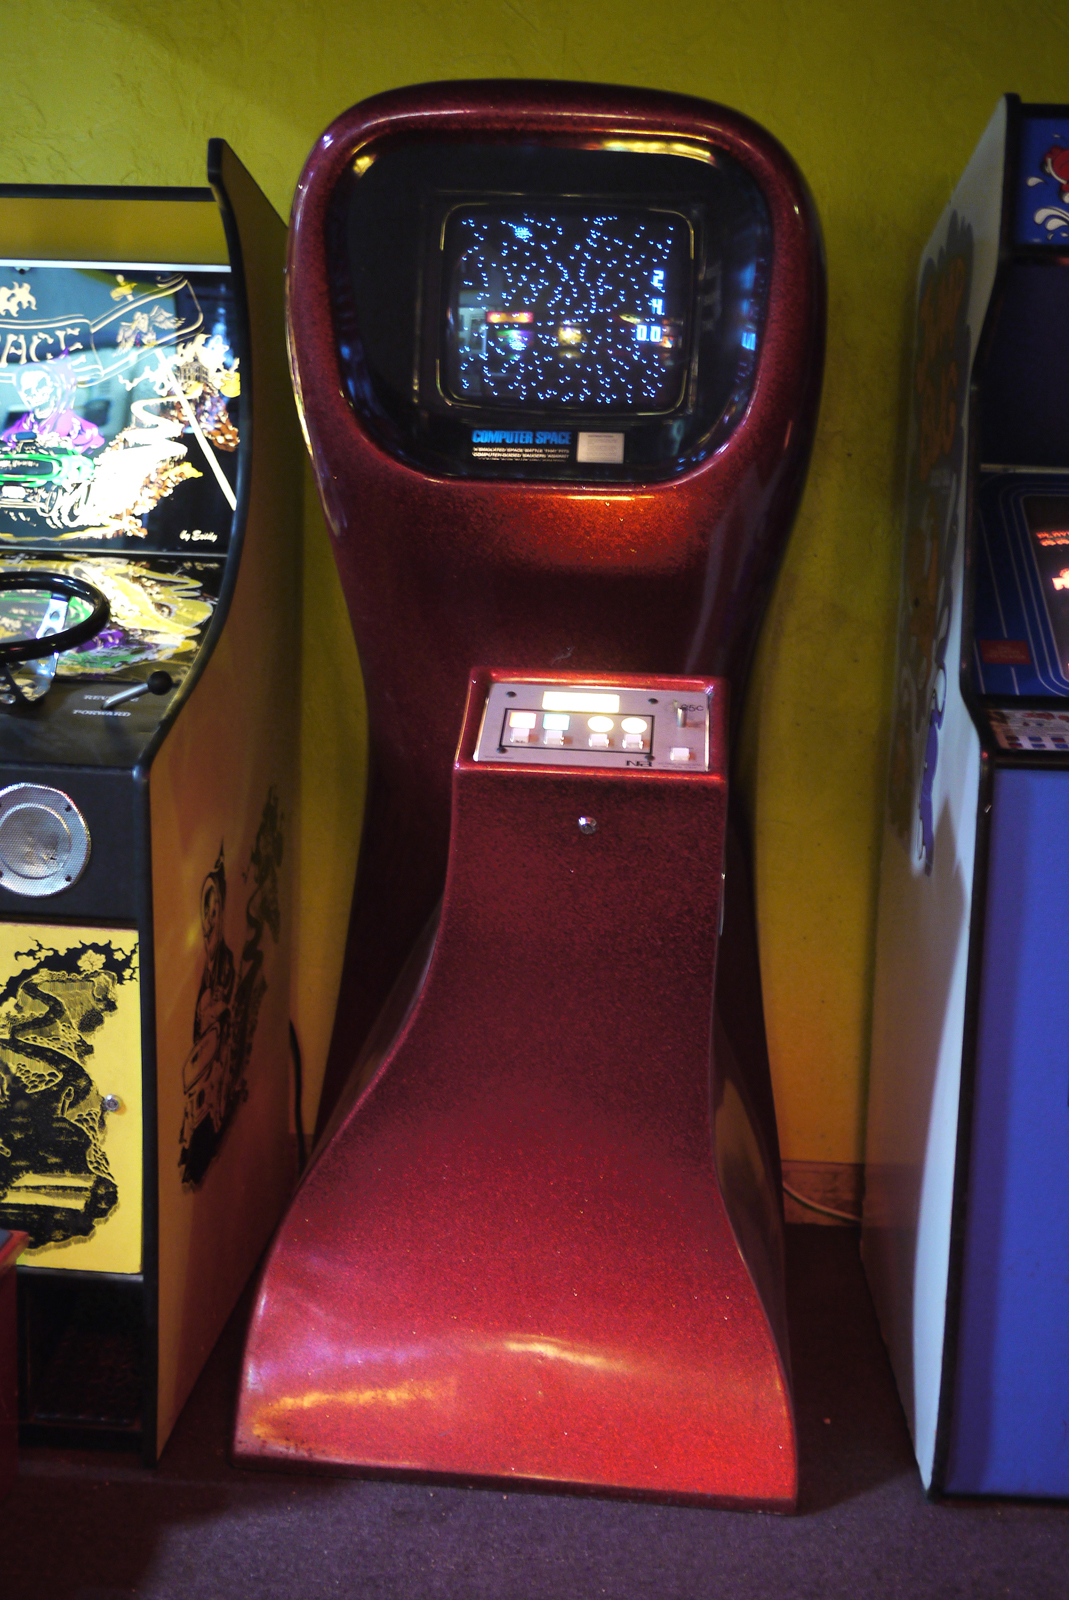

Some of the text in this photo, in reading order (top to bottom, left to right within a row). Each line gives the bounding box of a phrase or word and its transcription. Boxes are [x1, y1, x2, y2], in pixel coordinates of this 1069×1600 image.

[652, 269, 665, 287] 2
[0, 327, 87, 368] ACE
[472, 429, 572, 445] COMPUTER SPACE
[179, 529, 191, 542] by
[72, 709, 132, 718] FORWARD
